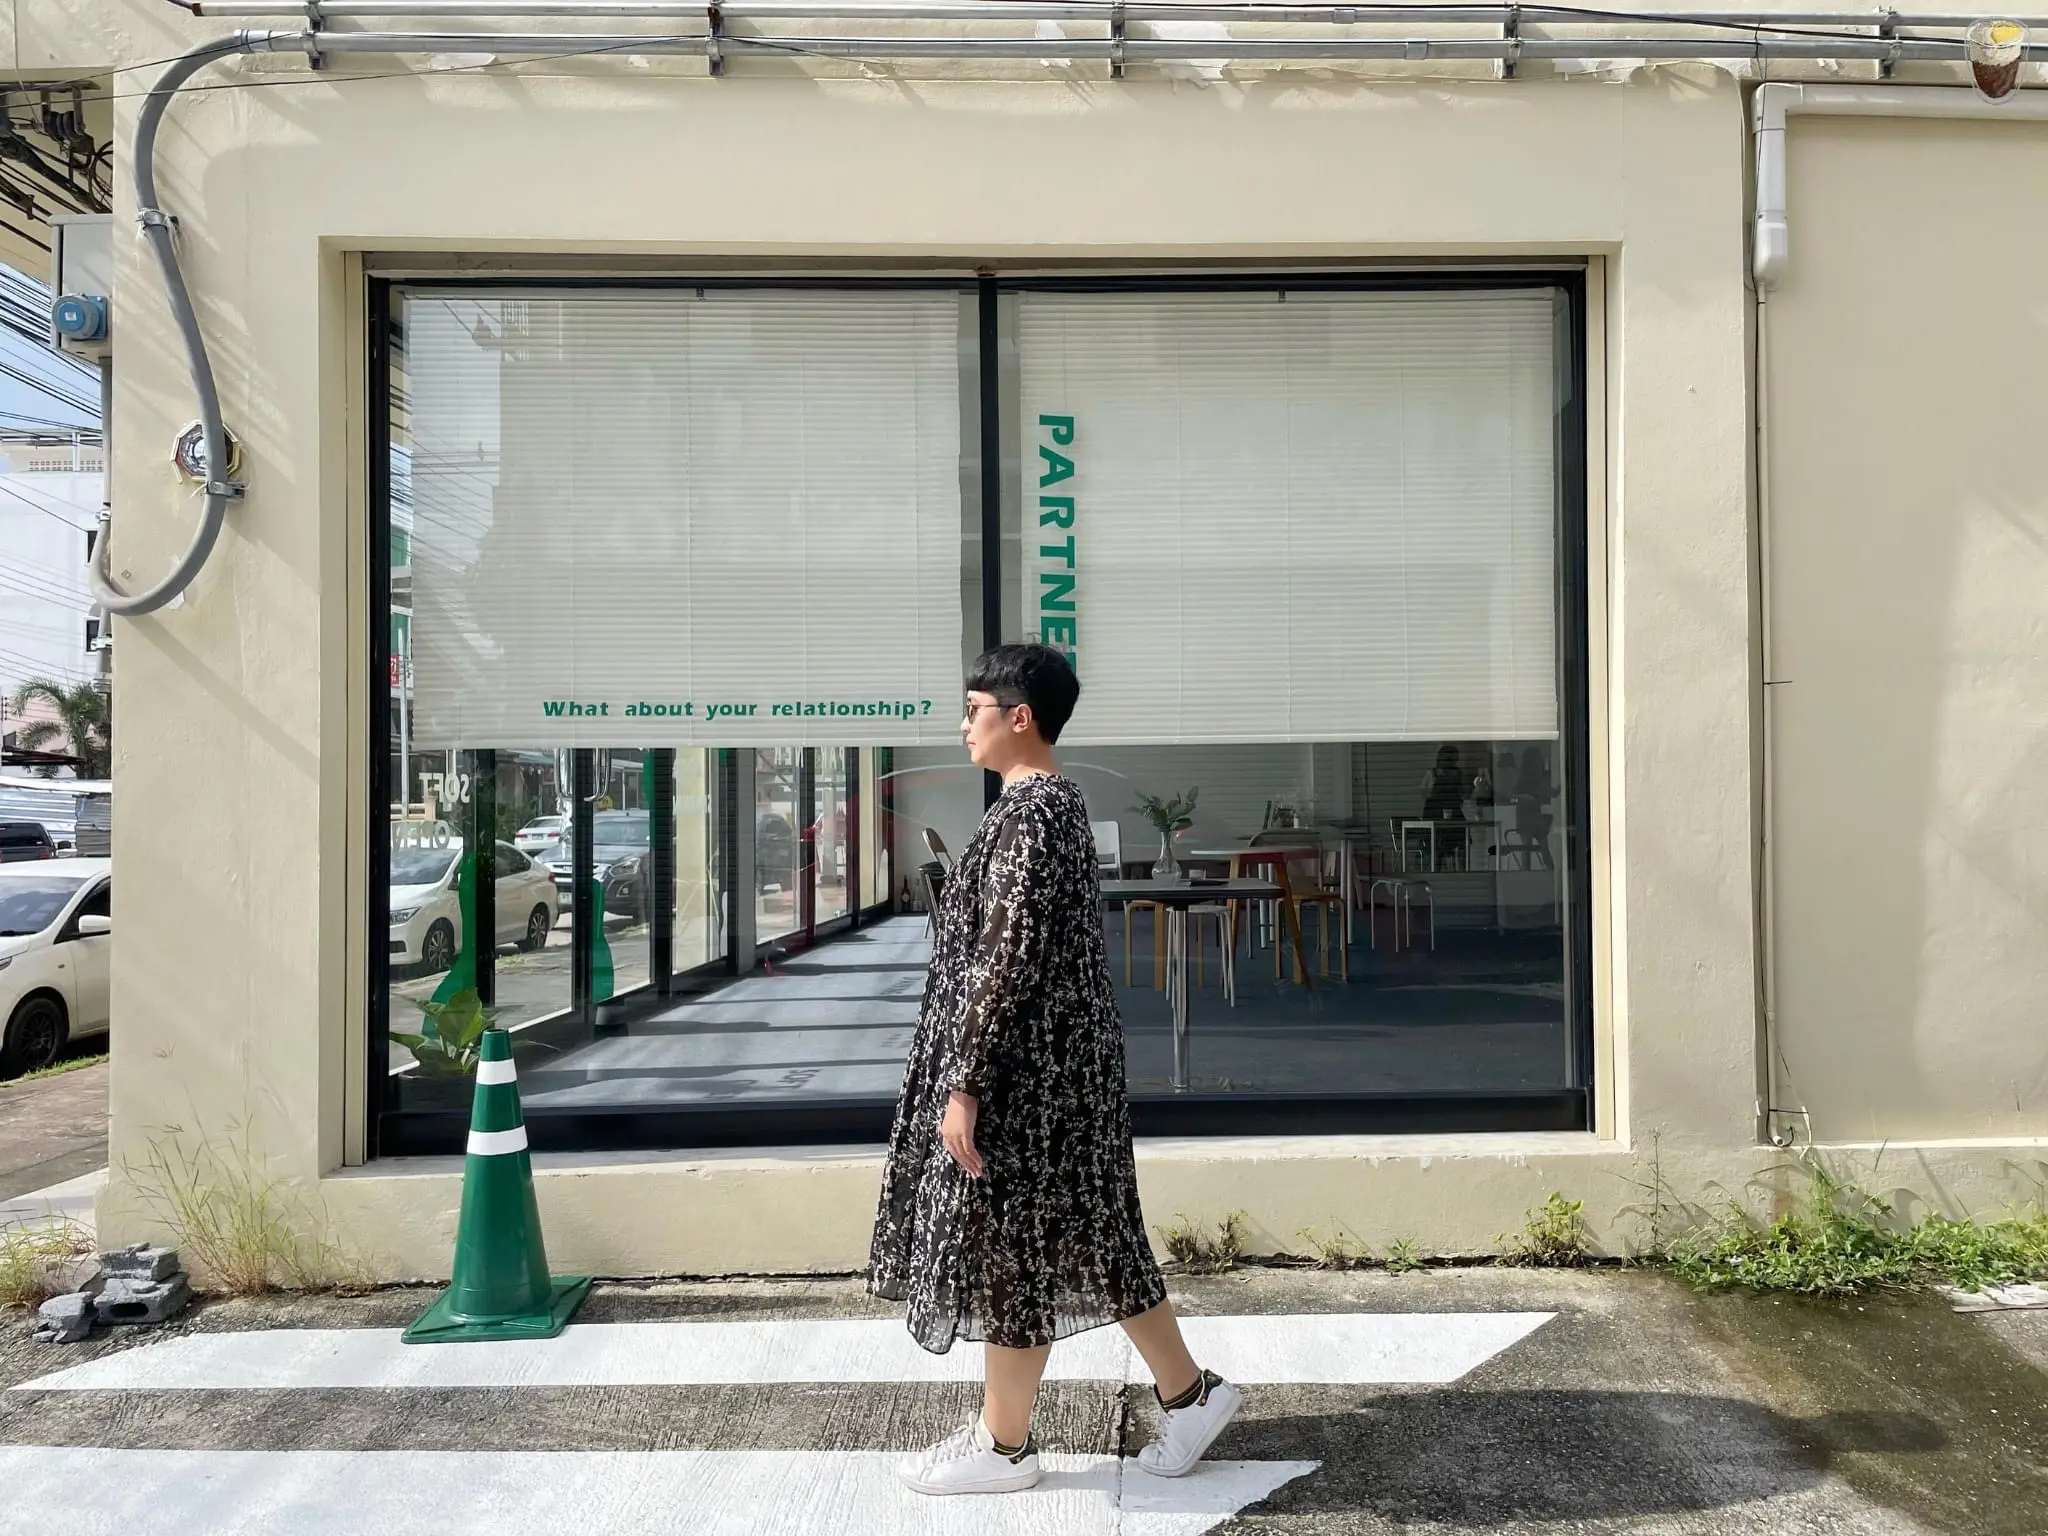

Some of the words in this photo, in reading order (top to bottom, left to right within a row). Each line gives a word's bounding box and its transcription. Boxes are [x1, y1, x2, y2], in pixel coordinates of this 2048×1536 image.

[1038, 414, 1077, 677] PARTNE
[543, 701, 609, 718] What
[624, 701, 693, 718] about
[705, 703, 757, 721] your
